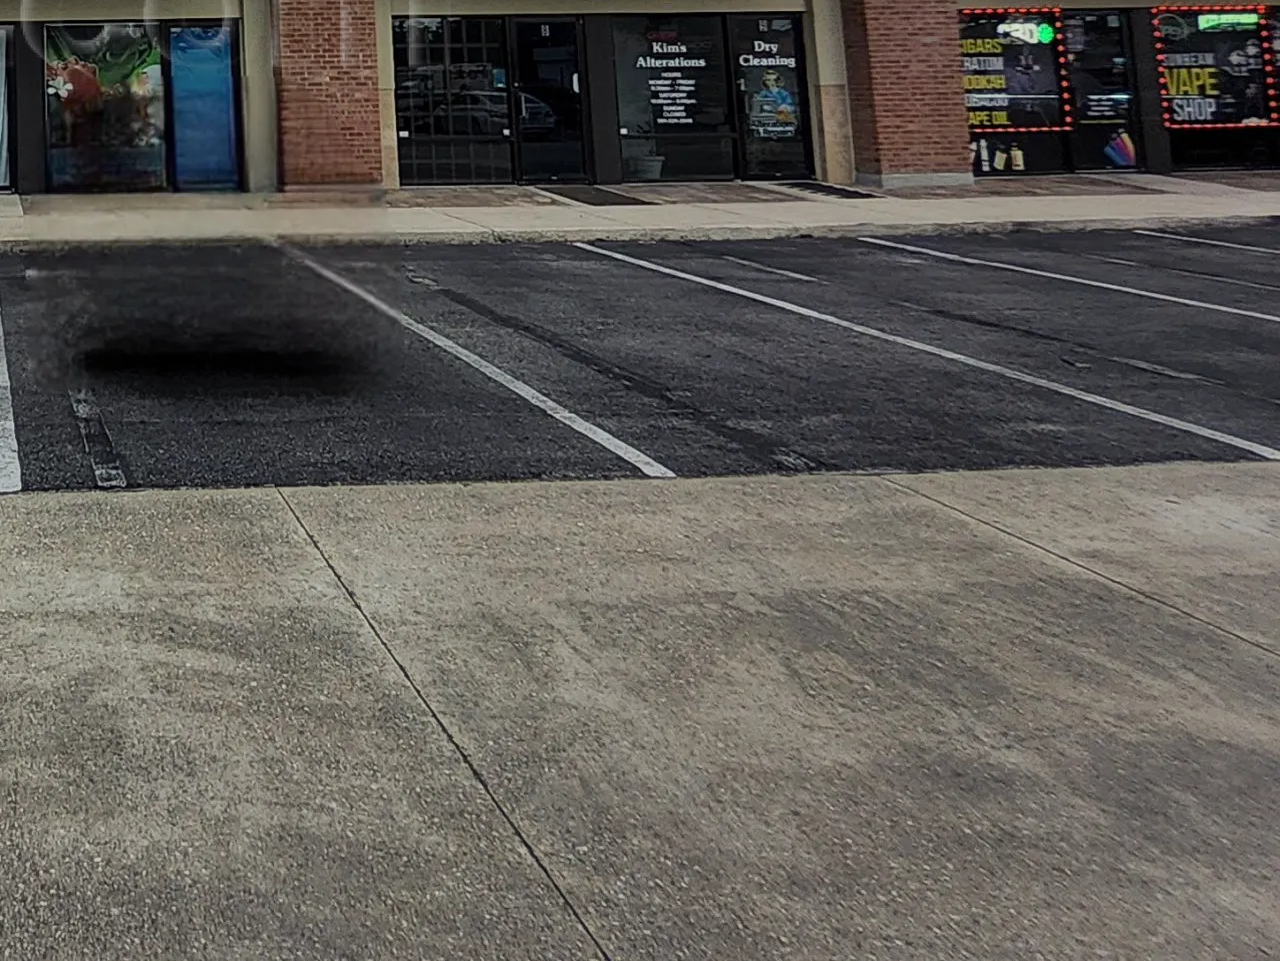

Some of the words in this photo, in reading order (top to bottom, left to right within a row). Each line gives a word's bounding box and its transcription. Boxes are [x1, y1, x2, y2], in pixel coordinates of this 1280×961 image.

[652, 42, 687, 53] Kim's
[753, 40, 778, 54] Dry
[961, 39, 1004, 53] IGARS
[636, 56, 706, 68] Alterations
[739, 54, 796, 68] Cleaning
[963, 56, 1004, 71] RATOM
[962, 74, 1007, 89] OOKAH
[1165, 68, 1220, 95] VAPE
[1172, 98, 1217, 120] SHOP
[968, 111, 990, 124] APE
